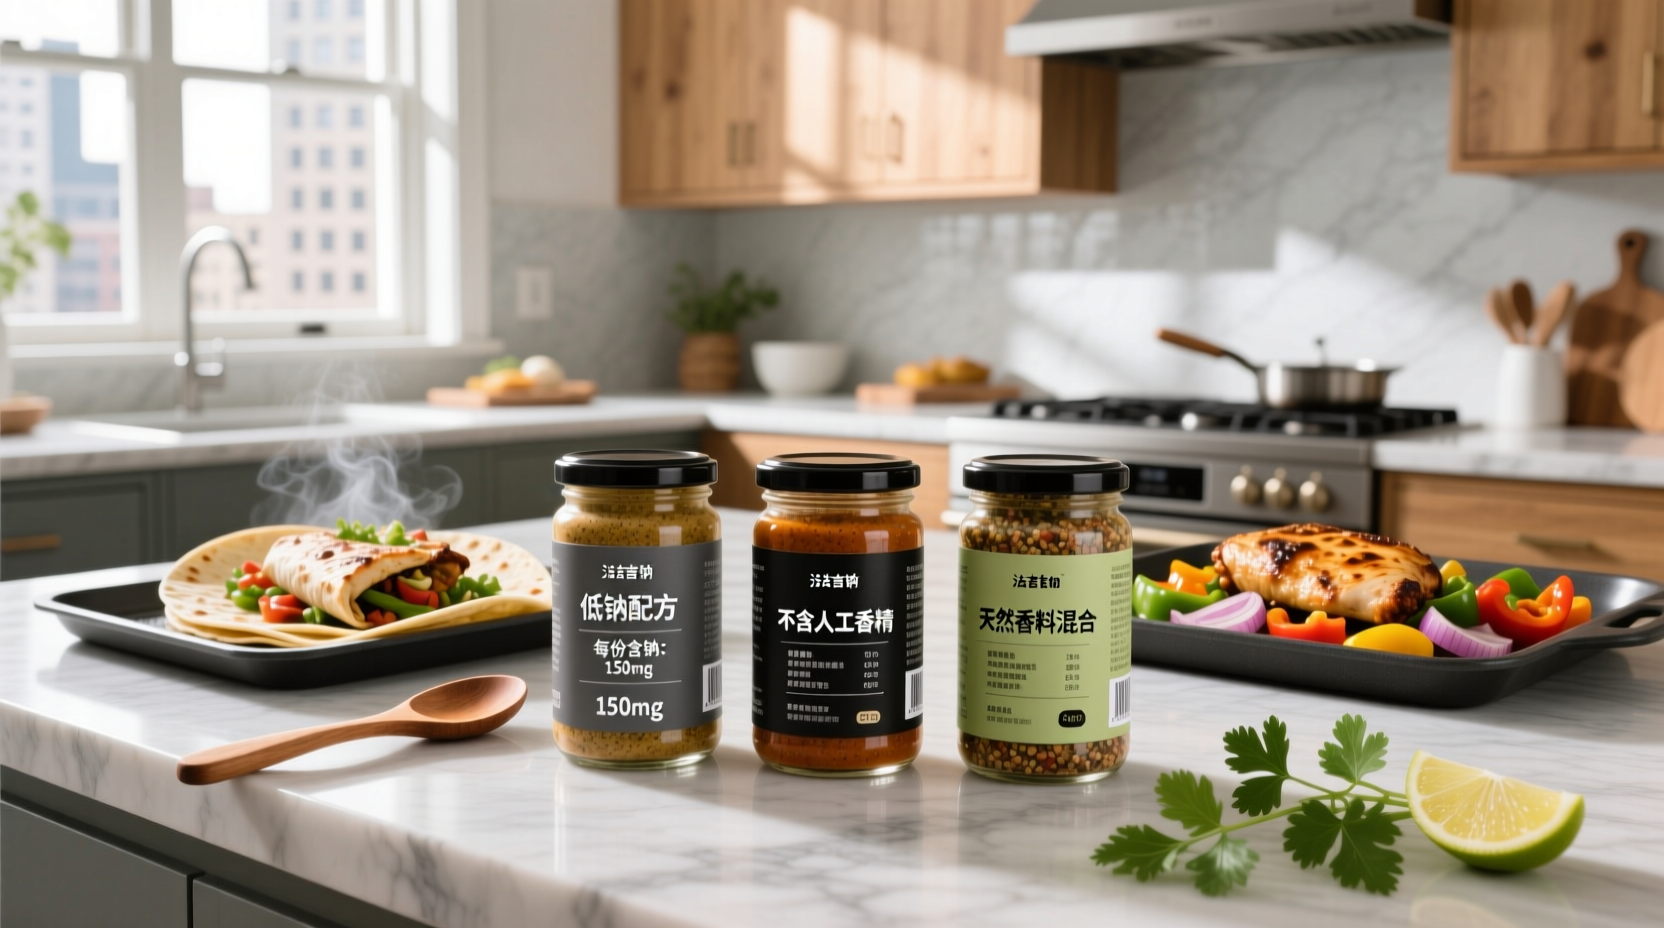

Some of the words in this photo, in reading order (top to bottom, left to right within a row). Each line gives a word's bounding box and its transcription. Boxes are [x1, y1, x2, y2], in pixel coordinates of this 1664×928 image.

[580, 592, 679, 622] 低钠配方
[777, 607, 894, 634] 不含人工香精
[979, 607, 1097, 635] 天然香料混合
[604, 659, 654, 680] 150mg
[596, 696, 664, 722] 150mg
